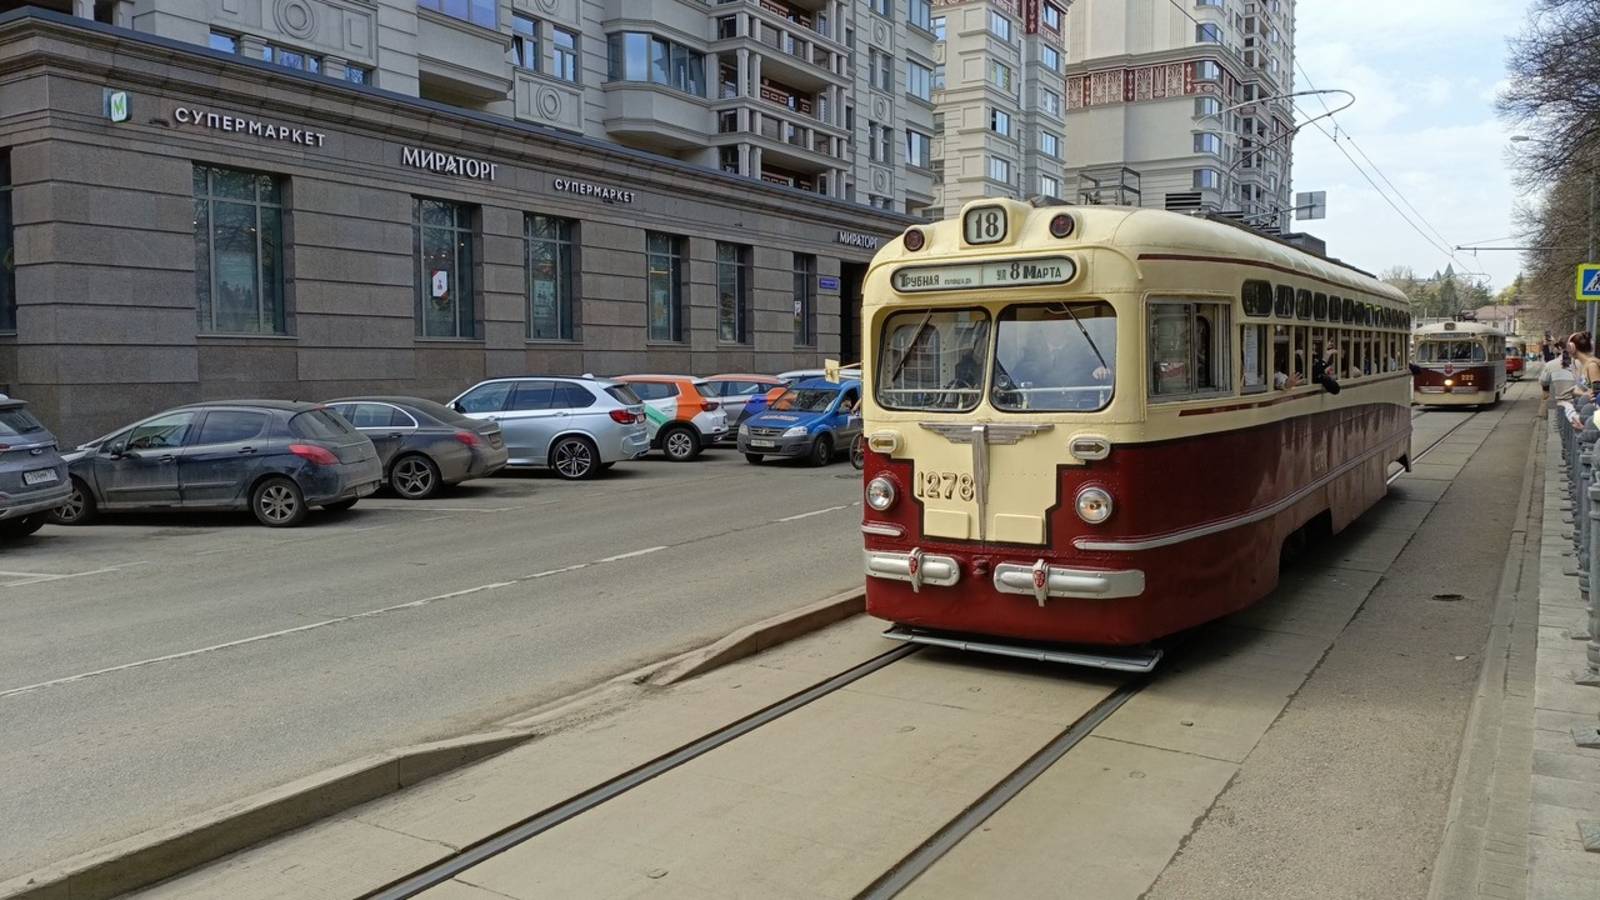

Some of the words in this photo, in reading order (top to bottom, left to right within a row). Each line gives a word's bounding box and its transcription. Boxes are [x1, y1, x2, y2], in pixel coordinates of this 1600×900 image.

[175, 107, 326, 147] СУПЕРМАРКЕТ
[402, 147, 498, 180] МИРАТОРГ
[554, 178, 636, 203] СУПЕРМАРКЕТ
[974, 212, 999, 239] 18
[839, 231, 878, 249] МИРАТОРГ
[1010, 262, 1020, 280] 8
[1023, 265, 1062, 280] МАРТА
[917, 471, 974, 502] 1278
